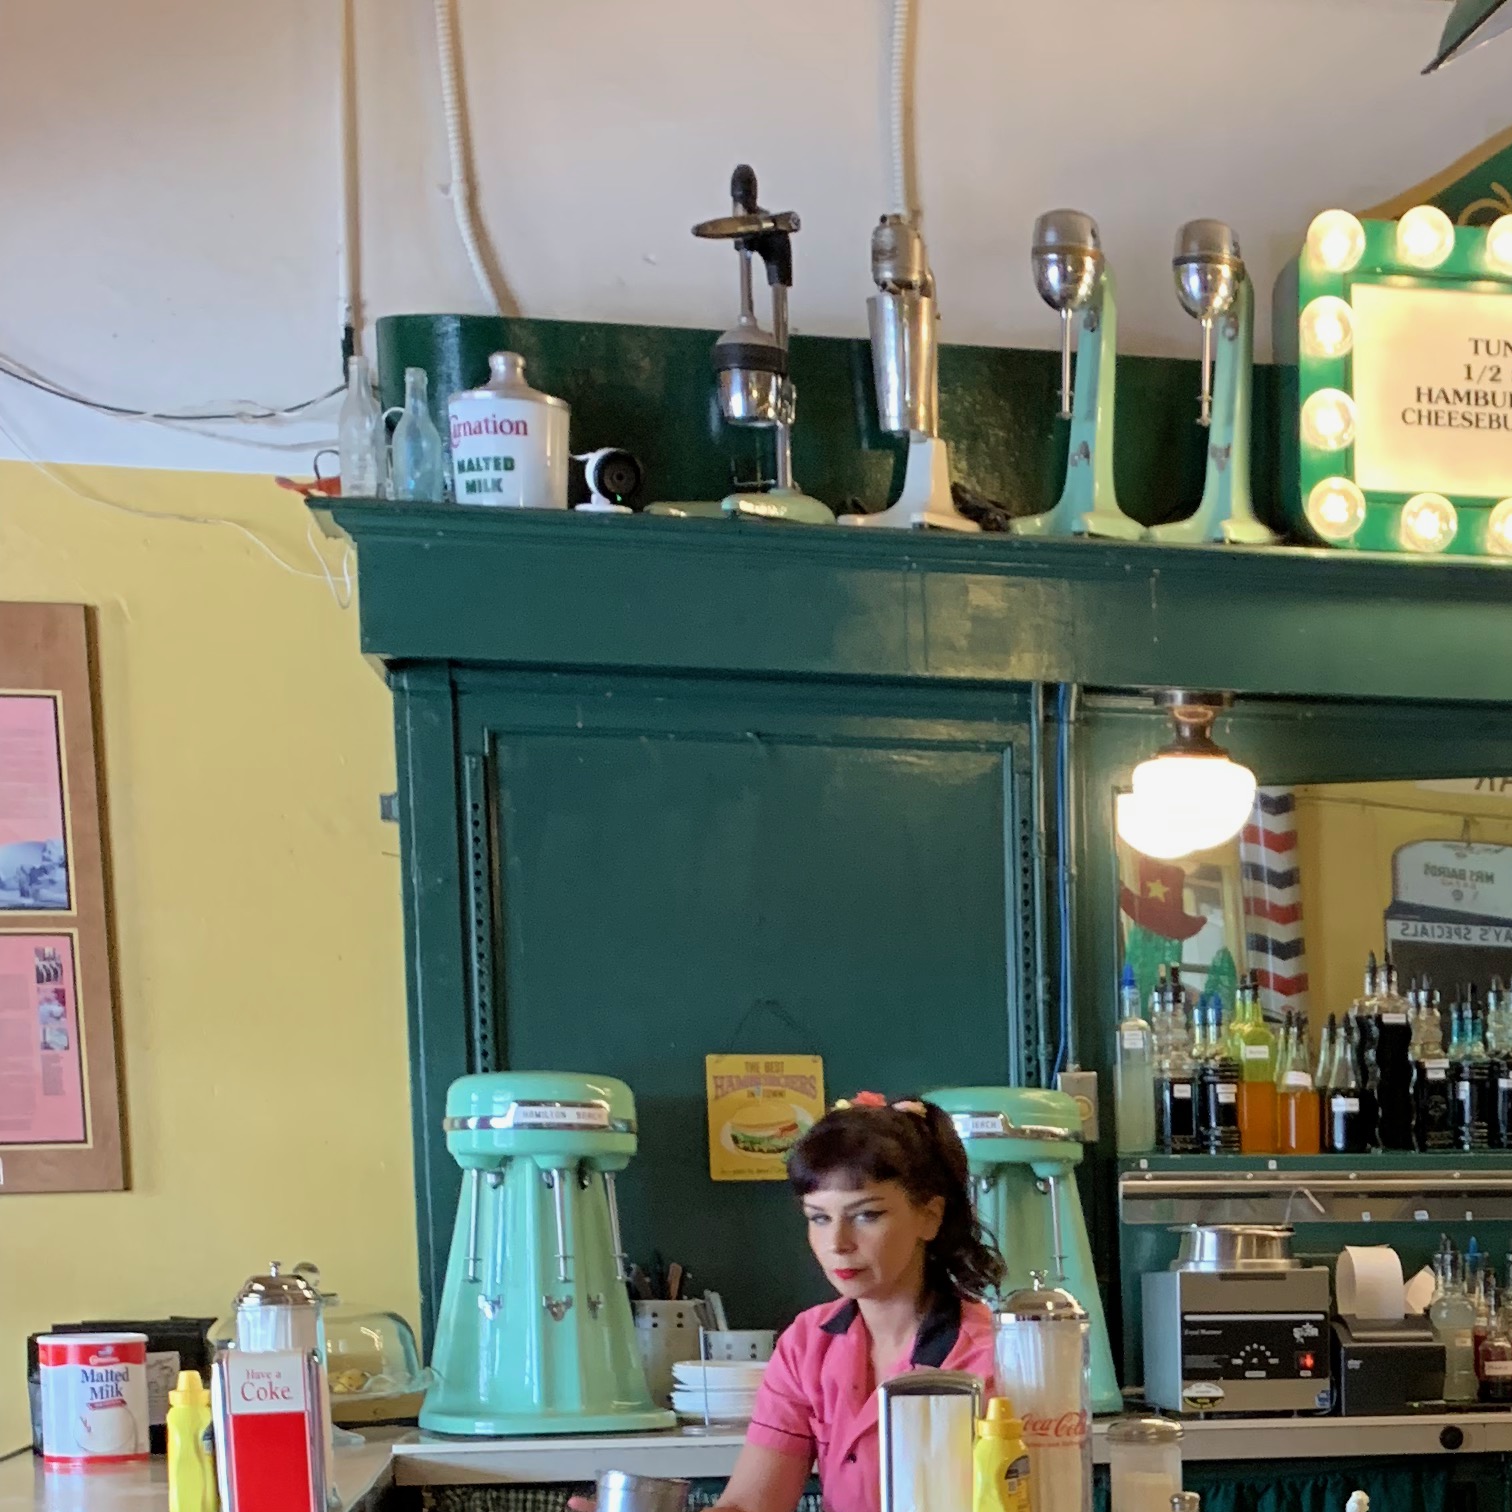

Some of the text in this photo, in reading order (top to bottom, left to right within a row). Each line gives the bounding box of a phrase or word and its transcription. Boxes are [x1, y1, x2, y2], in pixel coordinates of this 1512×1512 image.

[1463, 363, 1502, 385] 1/2
[457, 456, 515, 474] MALTED
[466, 477, 504, 495] MILK
[81, 1366, 130, 1383] Malted
[245, 1368, 272, 1380] Have
[89, 1384, 124, 1401] Milk
[241, 1380, 294, 1402] Coke
